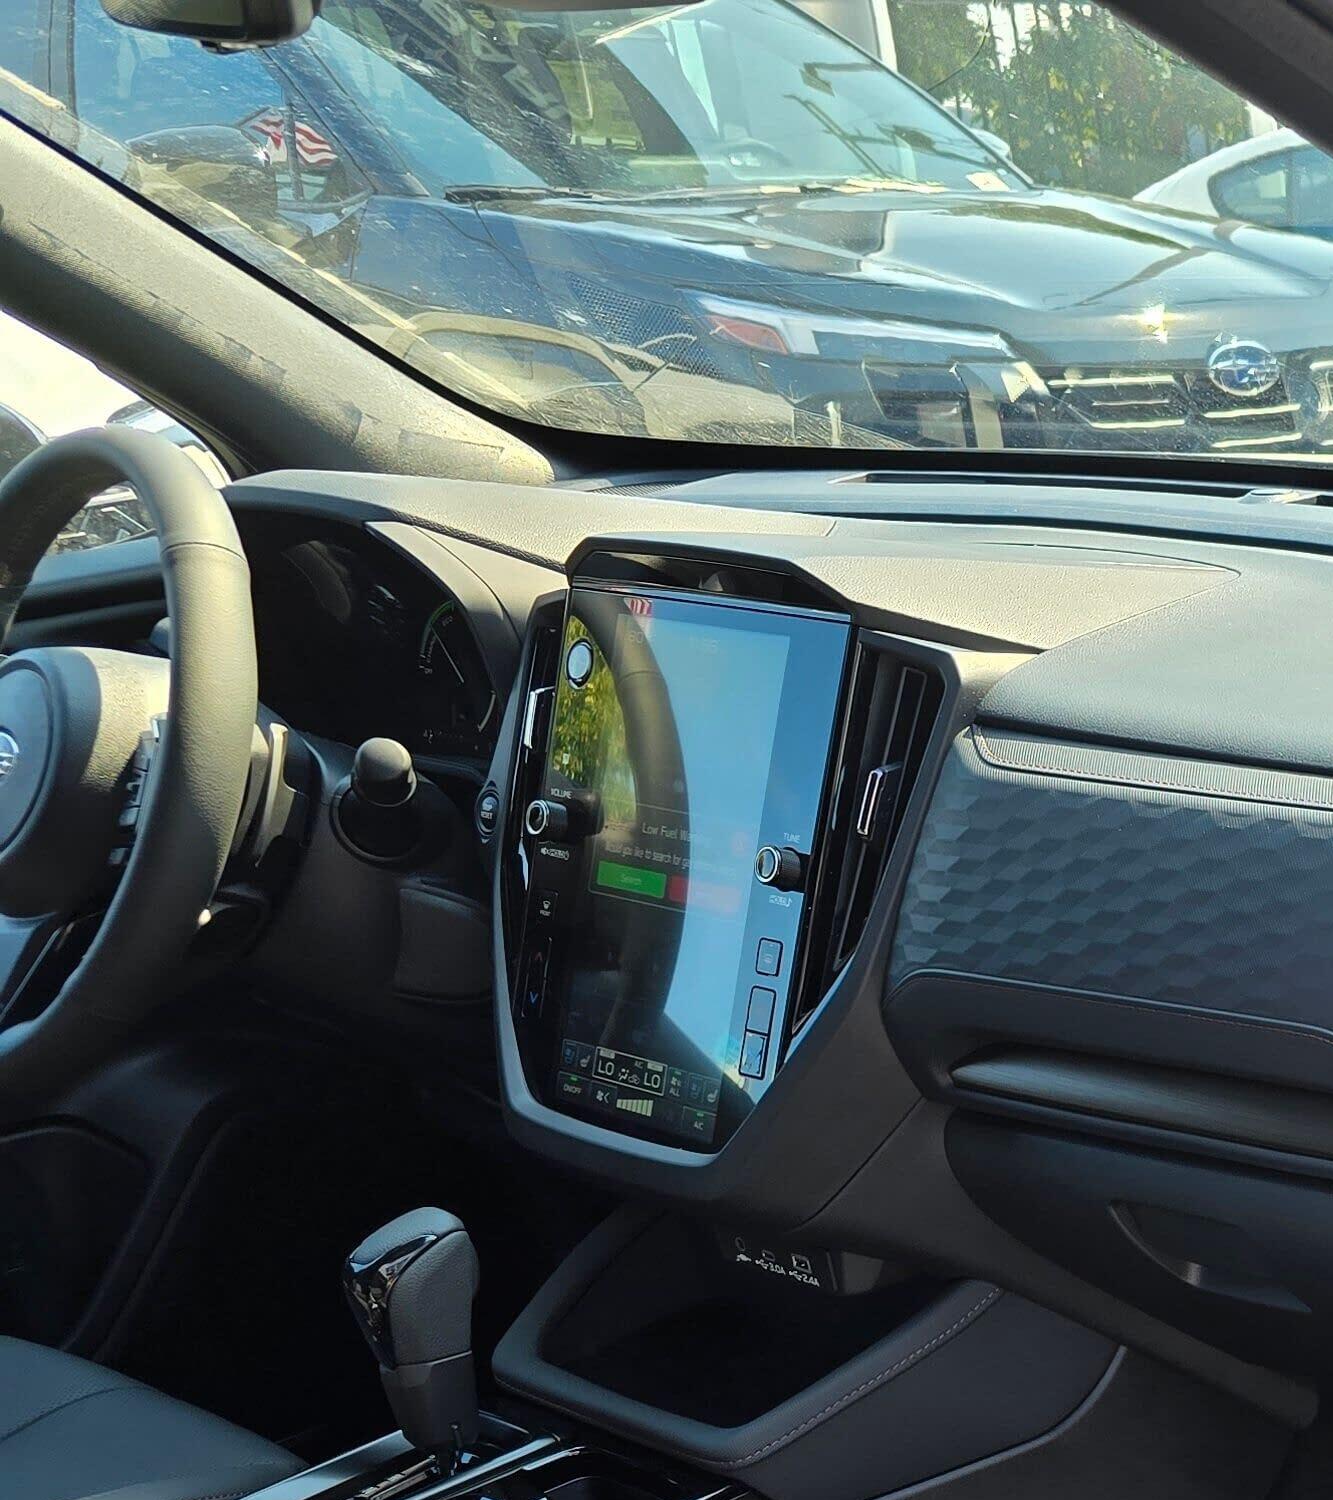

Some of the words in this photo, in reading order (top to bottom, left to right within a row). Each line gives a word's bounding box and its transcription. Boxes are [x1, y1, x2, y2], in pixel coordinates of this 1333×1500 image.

[642, 822, 659, 835] Low
[660, 825, 678, 839] Fuel
[783, 832, 801, 844] TUNE
[597, 1059, 615, 1077] LO
[643, 1071, 661, 1089] LO
